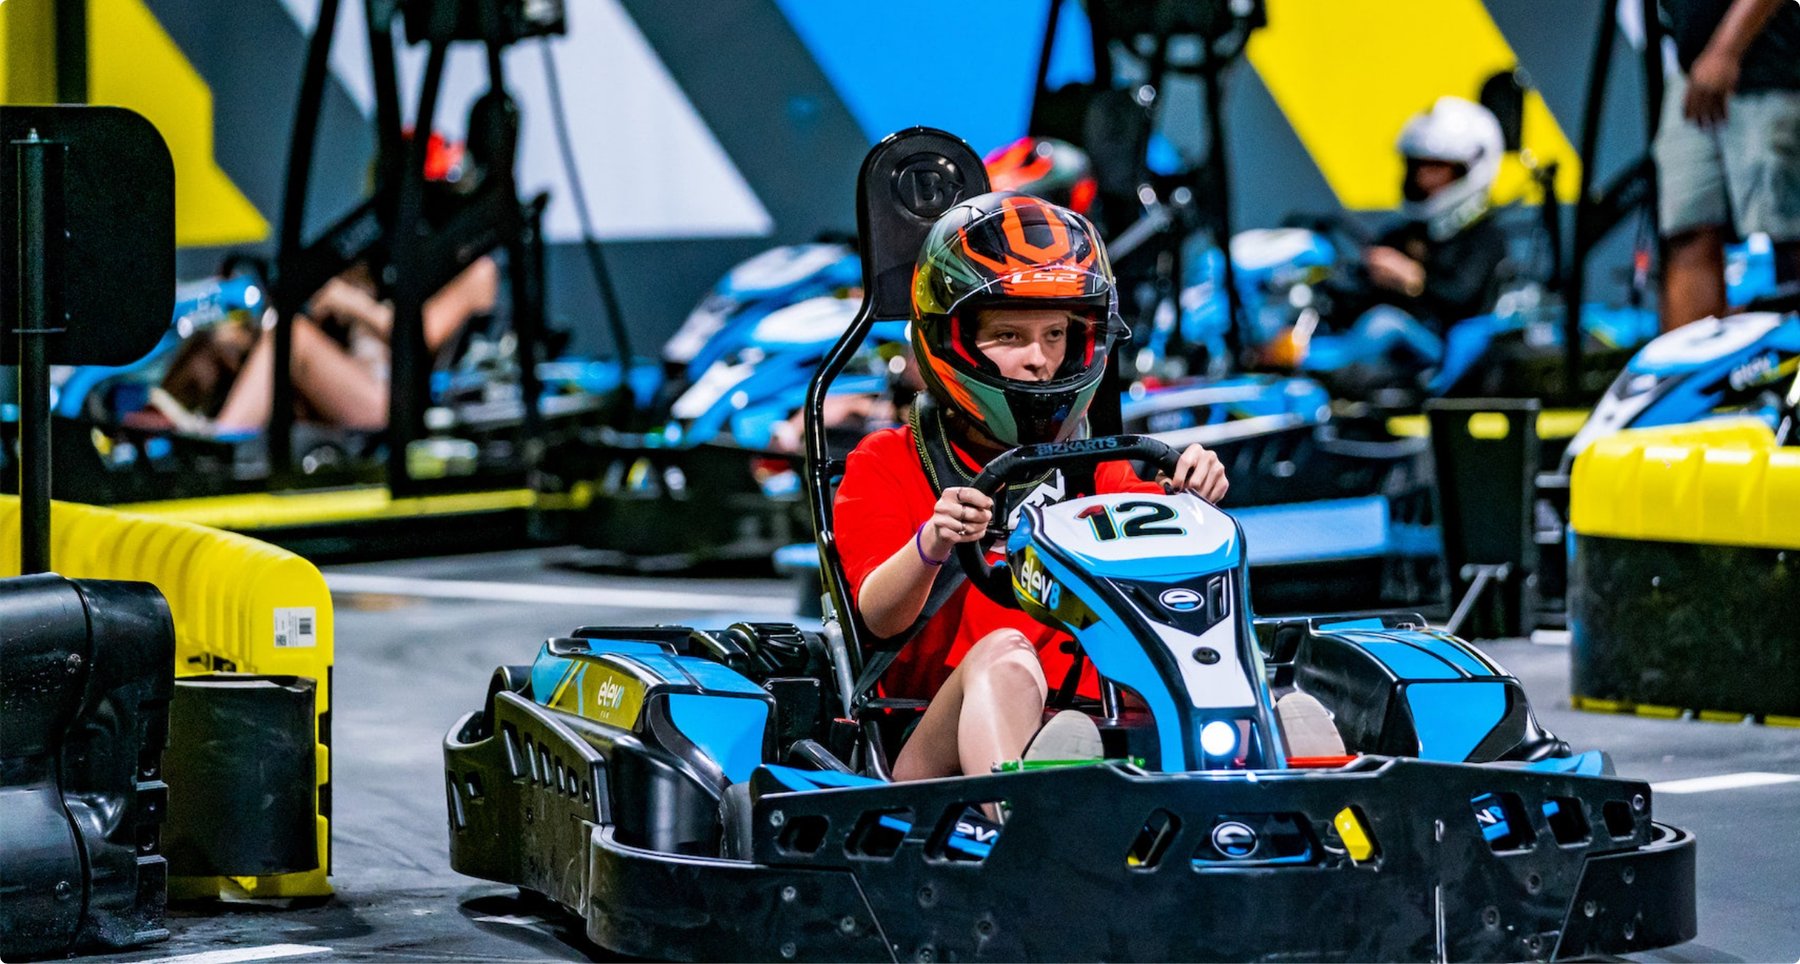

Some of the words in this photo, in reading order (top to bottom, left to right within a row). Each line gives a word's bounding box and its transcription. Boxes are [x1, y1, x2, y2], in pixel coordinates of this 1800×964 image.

[1010, 271, 1078, 284] LS2
[1036, 437, 1118, 456] BIZKARTS
[1074, 501, 1187, 541] 12
[1021, 558, 1061, 610] elev8
